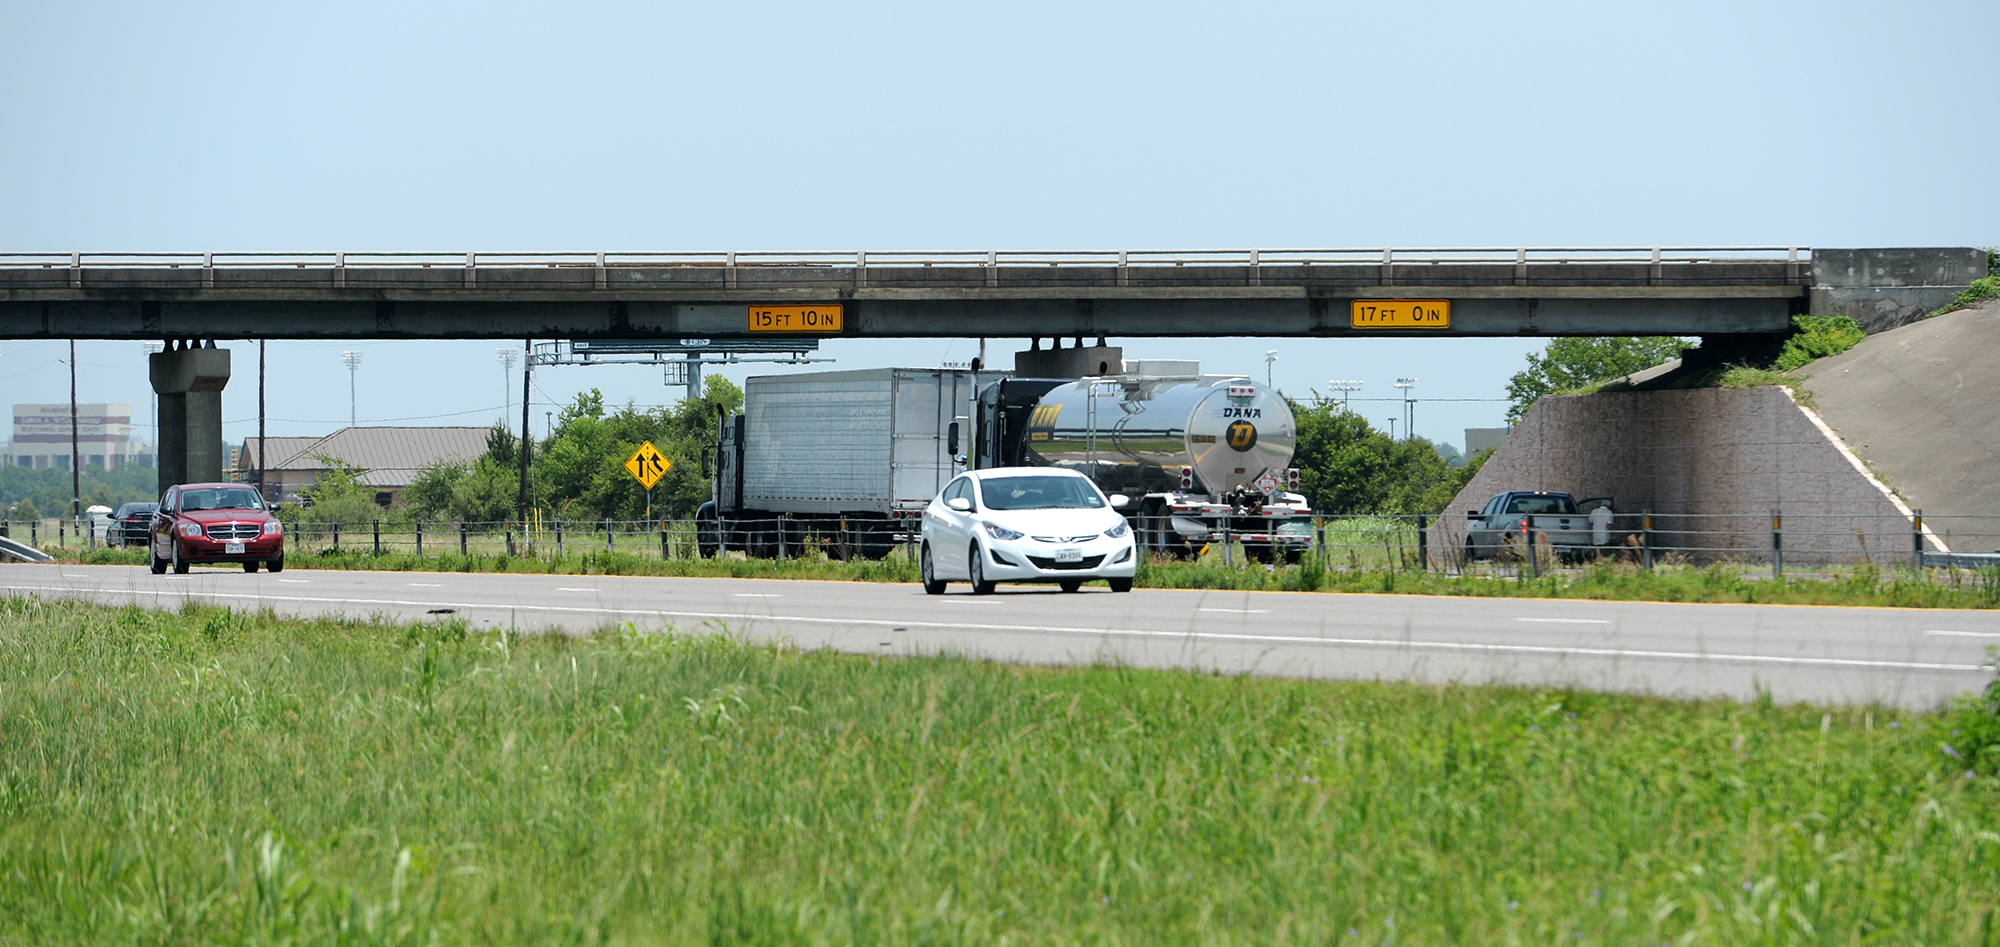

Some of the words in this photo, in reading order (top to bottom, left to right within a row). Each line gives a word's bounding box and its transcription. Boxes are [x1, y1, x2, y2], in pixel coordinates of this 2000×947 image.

[755, 311, 772, 326] 15
[776, 315, 791, 326] FT
[801, 310, 818, 326] 10
[821, 314, 833, 326] IN
[1360, 306, 1377, 321] 17
[1381, 310, 1396, 321] FT
[1412, 306, 1423, 321] 0
[1427, 310, 1440, 321] IN
[1223, 407, 1261, 419] DANA
[1231, 424, 1254, 447] D
